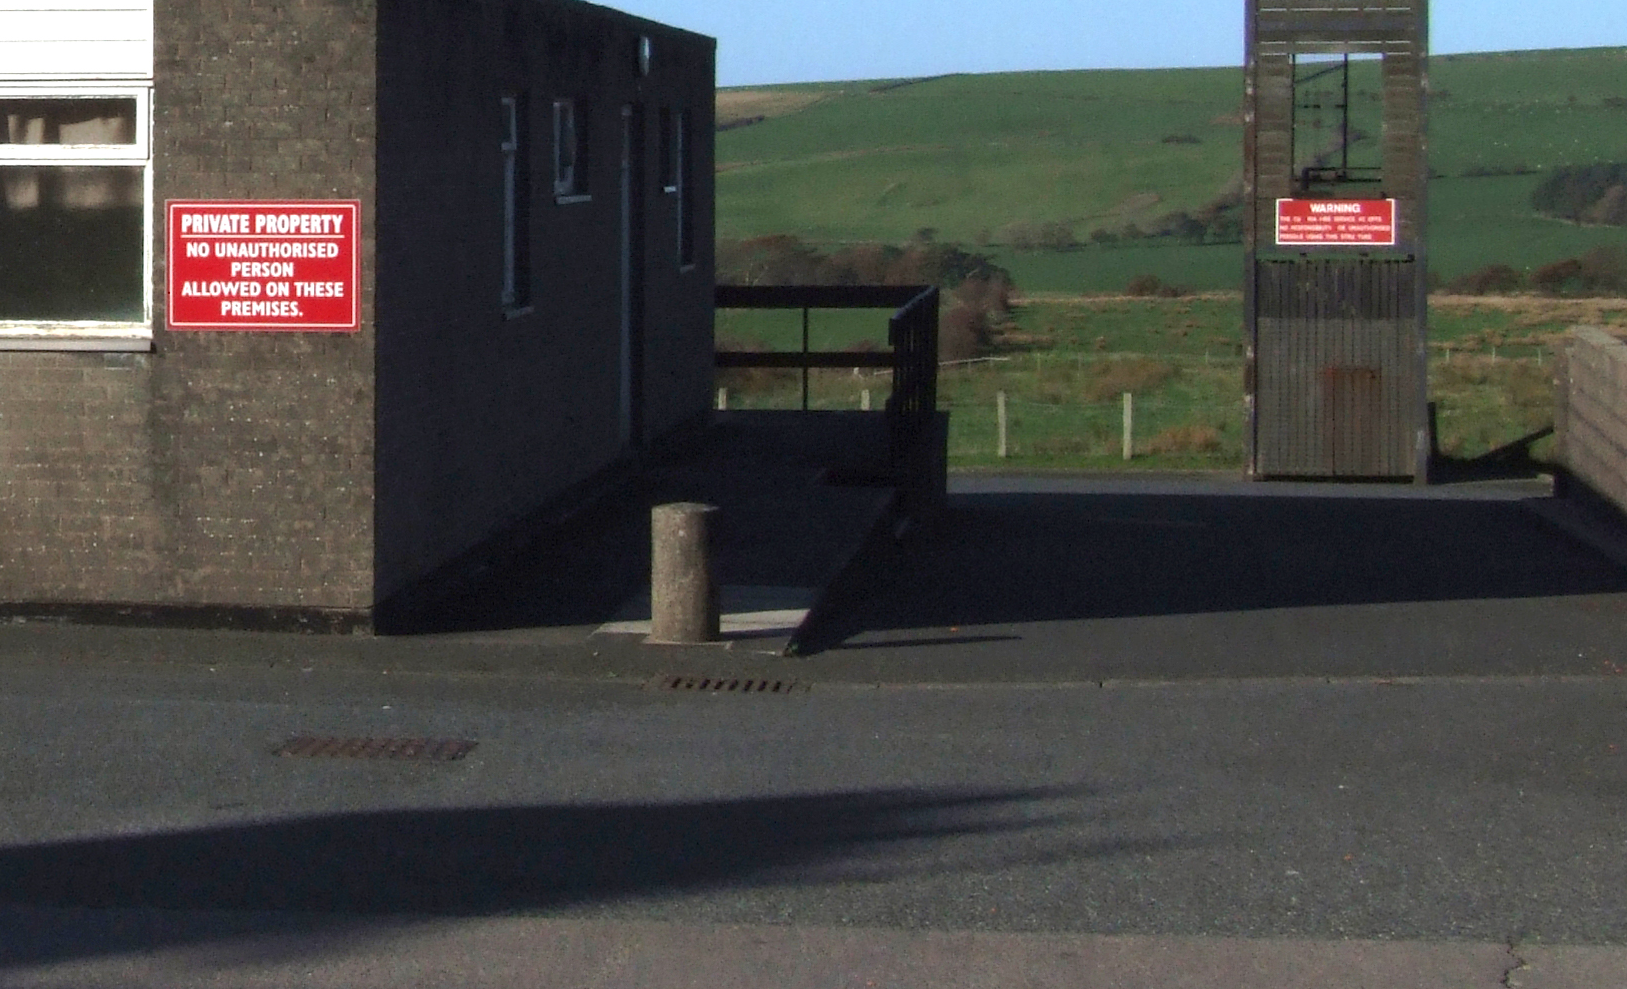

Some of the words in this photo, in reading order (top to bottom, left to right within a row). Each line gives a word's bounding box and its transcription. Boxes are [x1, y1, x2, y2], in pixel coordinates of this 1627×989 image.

[1309, 203, 1361, 213] WARNING
[181, 214, 249, 233] PRIVATE
[255, 214, 343, 234] PROPERTY
[186, 242, 210, 258] NO
[214, 242, 339, 258] UNAUTHORISED
[231, 262, 294, 278] PERSON
[181, 281, 261, 297] ALLOWED
[265, 281, 290, 297] ON
[294, 282, 344, 298] THESE
[221, 301, 303, 317] PREMISES.
